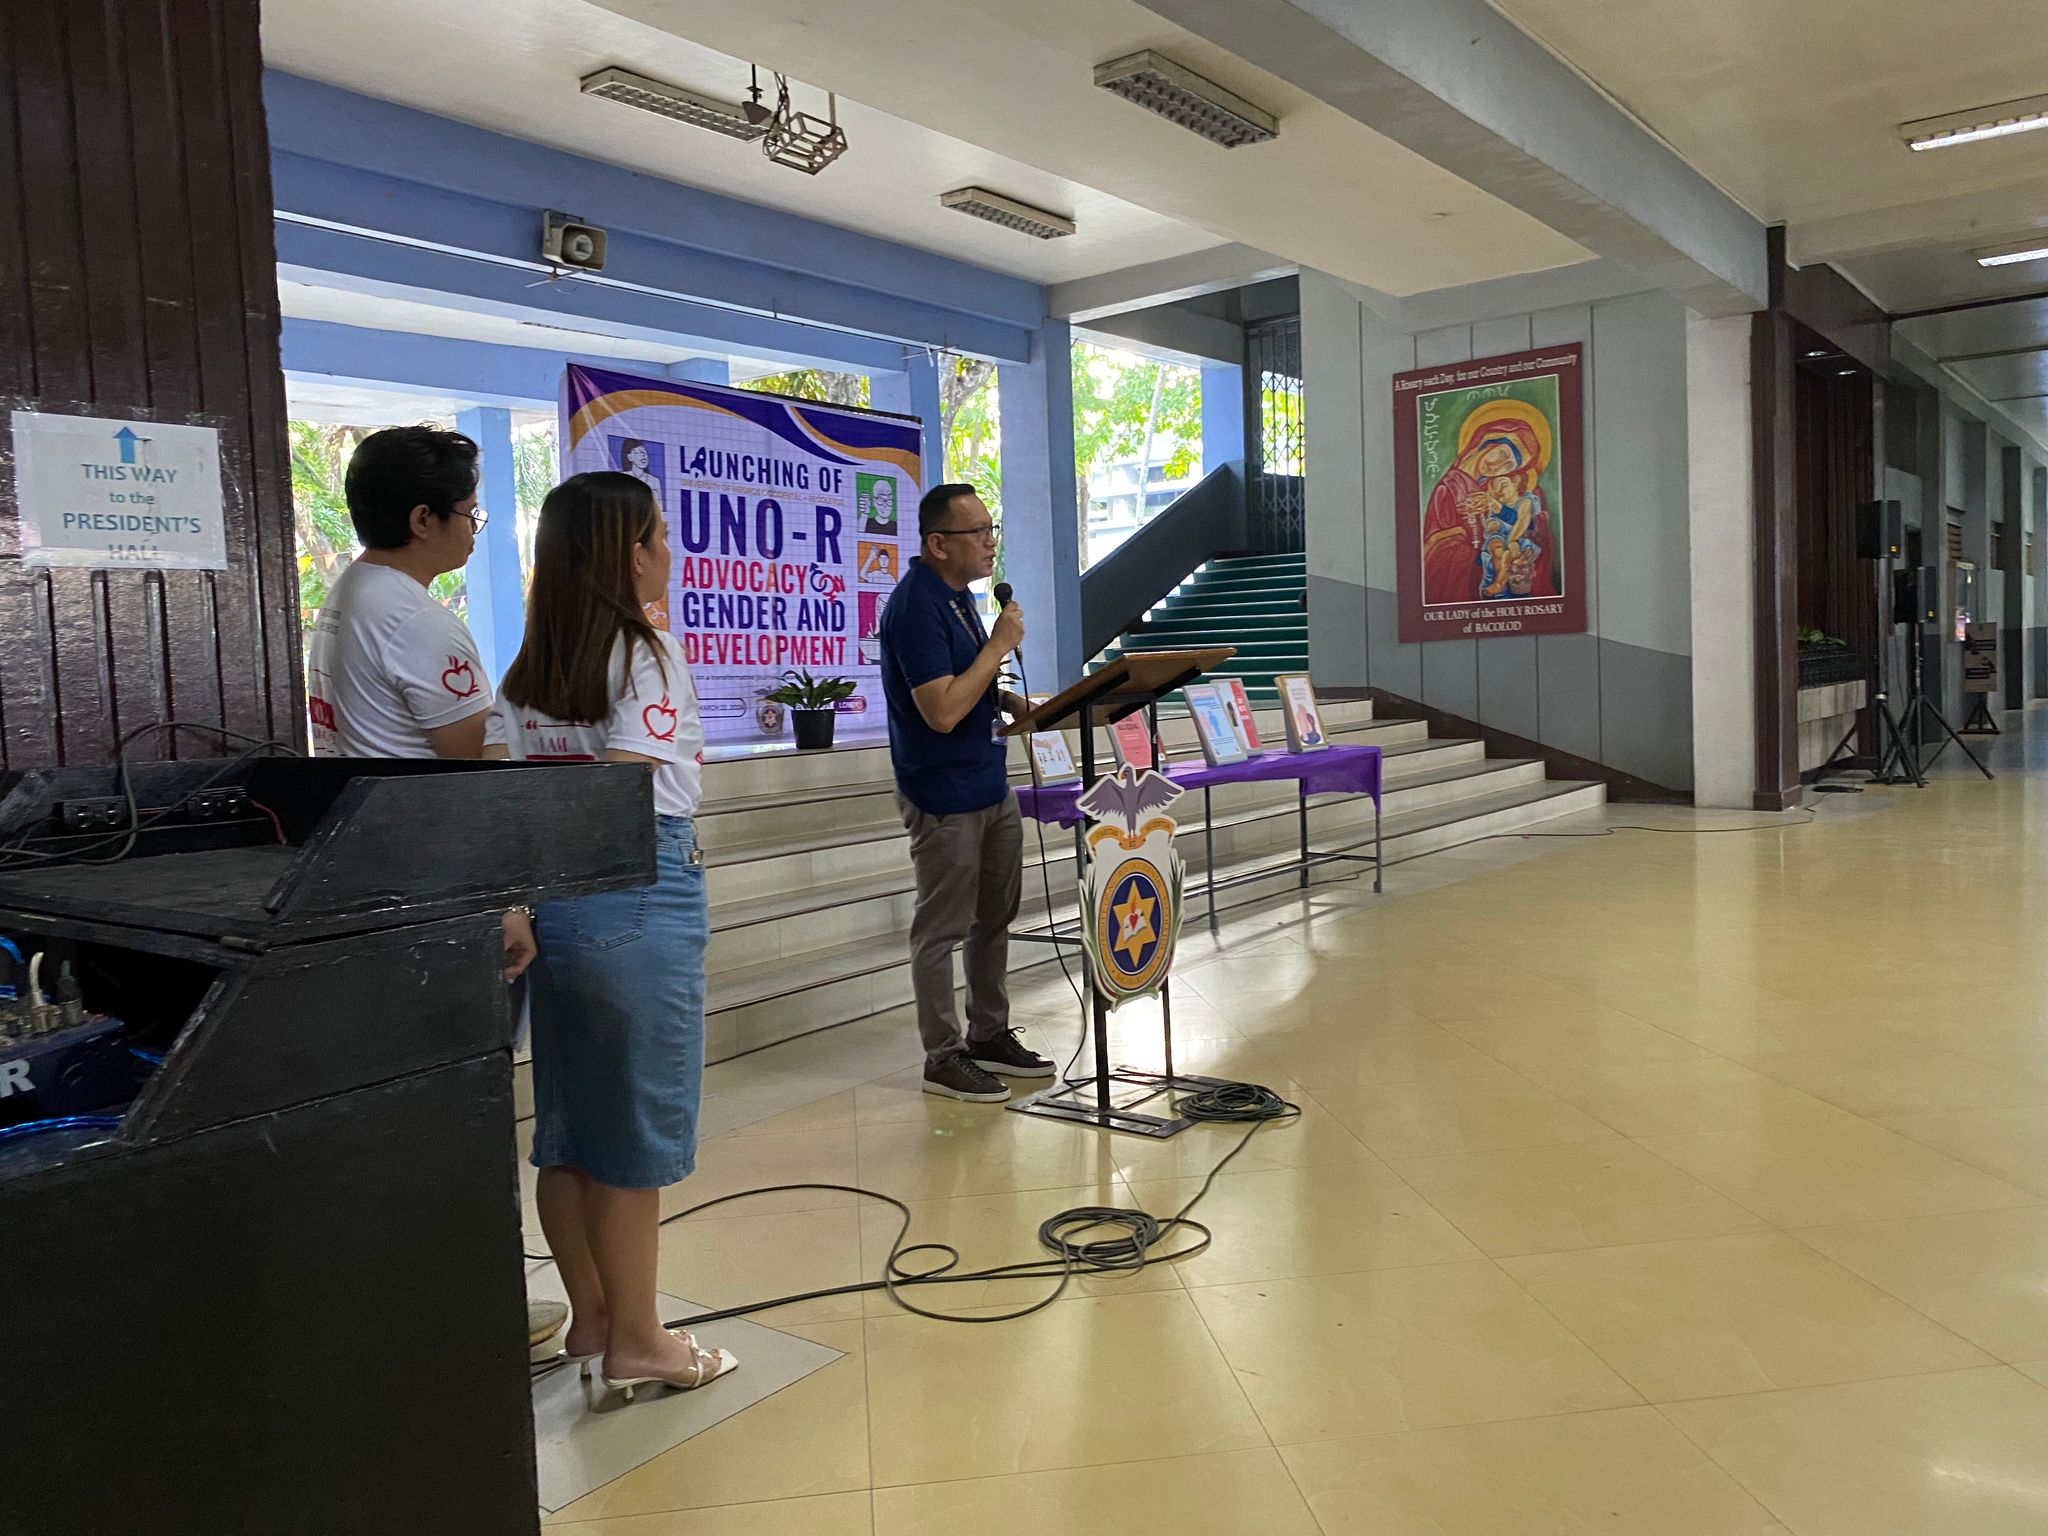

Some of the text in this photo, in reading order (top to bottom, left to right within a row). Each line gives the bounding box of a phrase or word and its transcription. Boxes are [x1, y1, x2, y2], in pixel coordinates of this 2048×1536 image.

[81, 463, 178, 484] THIS WAY
[819, 466, 843, 494] OF
[109, 491, 155, 505] to the
[62, 512, 202, 534] PRESIDENT'S
[108, 544, 164, 561] HALL
[681, 556, 808, 594] ADVOCACY
[683, 591, 845, 632] GENDER AND
[1424, 603, 1564, 621] OUR LADY of the HOLY ROSARY
[1463, 621, 1522, 633] of BACOLOD
[684, 632, 847, 666] DEVELOPMENT
